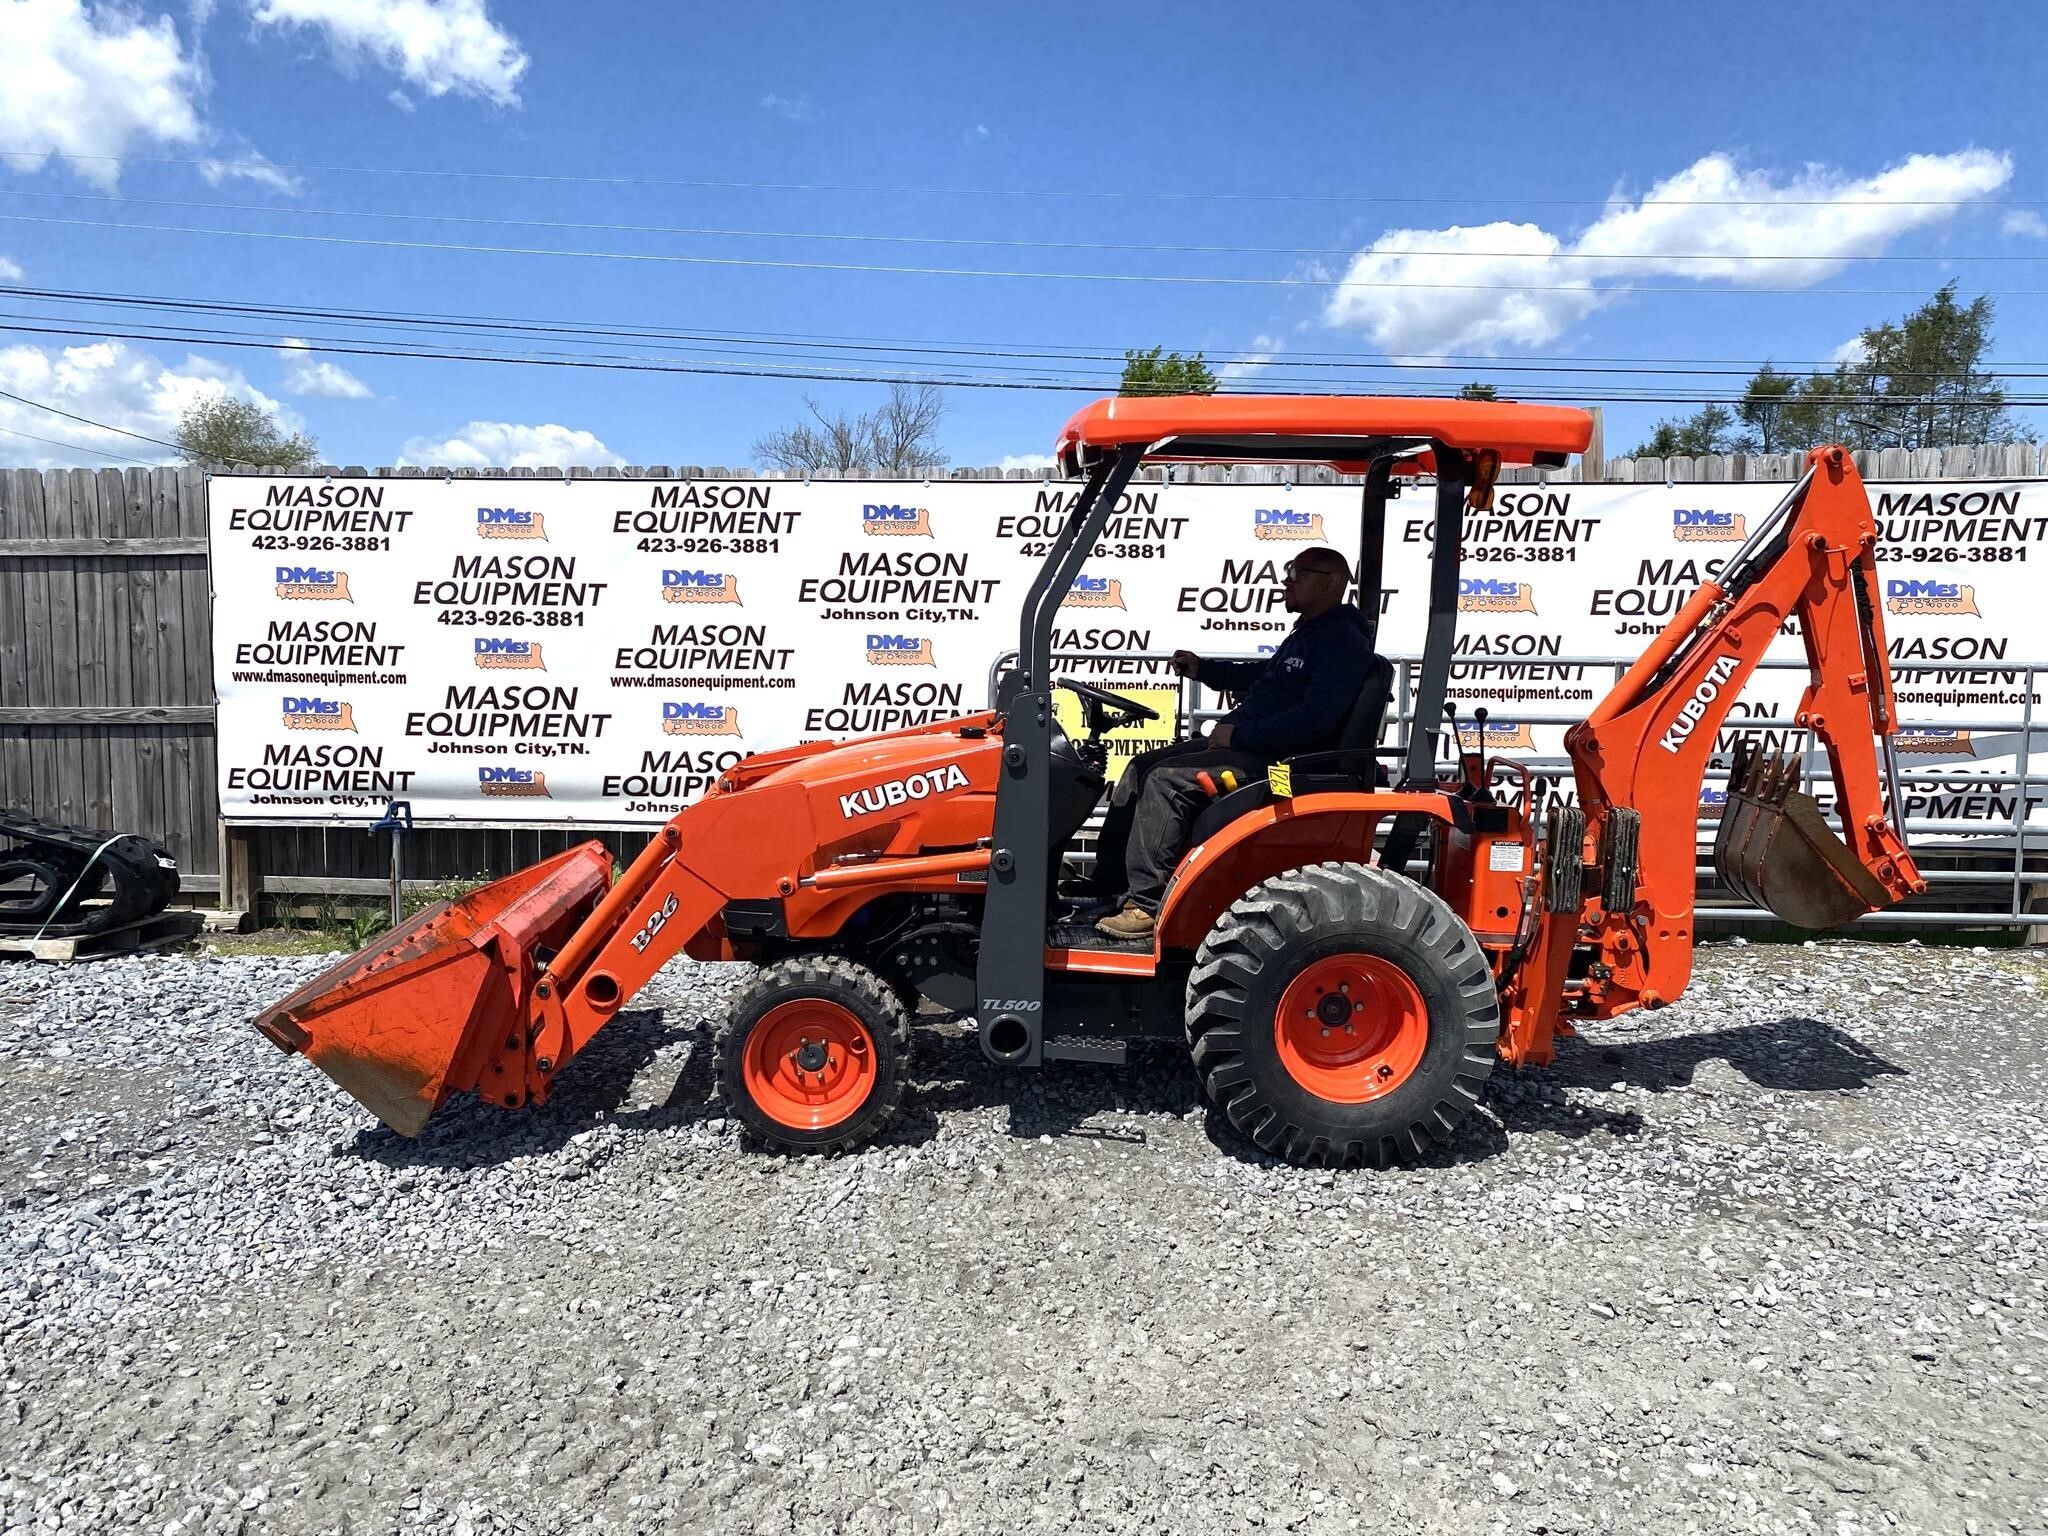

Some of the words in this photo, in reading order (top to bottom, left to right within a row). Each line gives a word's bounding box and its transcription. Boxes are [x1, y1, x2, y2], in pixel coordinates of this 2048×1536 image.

[265, 485, 384, 508] MASON
[651, 486, 771, 509] MASON
[1035, 490, 1159, 515] MAON
[1877, 491, 2021, 517] MASON
[229, 508, 413, 532] EQUIPMENT
[613, 510, 801, 534] EQUIPMENT
[996, 516, 1189, 540] EQUMENT
[252, 535, 390, 551] 423-926-3881
[637, 538, 780, 553] 423-926-3881
[1875, 546, 2027, 563] 23-926-3881
[451, 555, 576, 580] MASON
[838, 552, 969, 577] MASON
[413, 581, 608, 607] EQUIPMENT
[798, 579, 1000, 604] EQUIPMENT
[437, 610, 584, 627] 423-926-3881
[820, 608, 900, 621] Johnson
[905, 608, 980, 623] City,TN.
[1200, 618, 1285, 631] Johnson
[267, 621, 377, 642] MASON
[651, 624, 767, 647] MASON
[235, 643, 405, 666] EQUIPMENT
[614, 647, 795, 670] EQUIPMENT
[232, 670, 407, 686] www.dmasonequipment.com
[610, 674, 796, 691] www.dmasonequipment.com
[445, 685, 578, 710] MASON
[843, 683, 962, 706] MASON
[1659, 655, 1742, 754] KUBOTA
[404, 712, 612, 738] EQUIPMENT
[263, 744, 383, 768] MASON
[427, 742, 508, 755] Johnson
[514, 742, 590, 757] City,TN.
[228, 767, 415, 792] EQUIPMENT
[249, 794, 324, 805] Johnson
[839, 764, 970, 819] KUBOTA
[629, 891, 679, 954] B26
[983, 999, 1041, 1011] TL500
